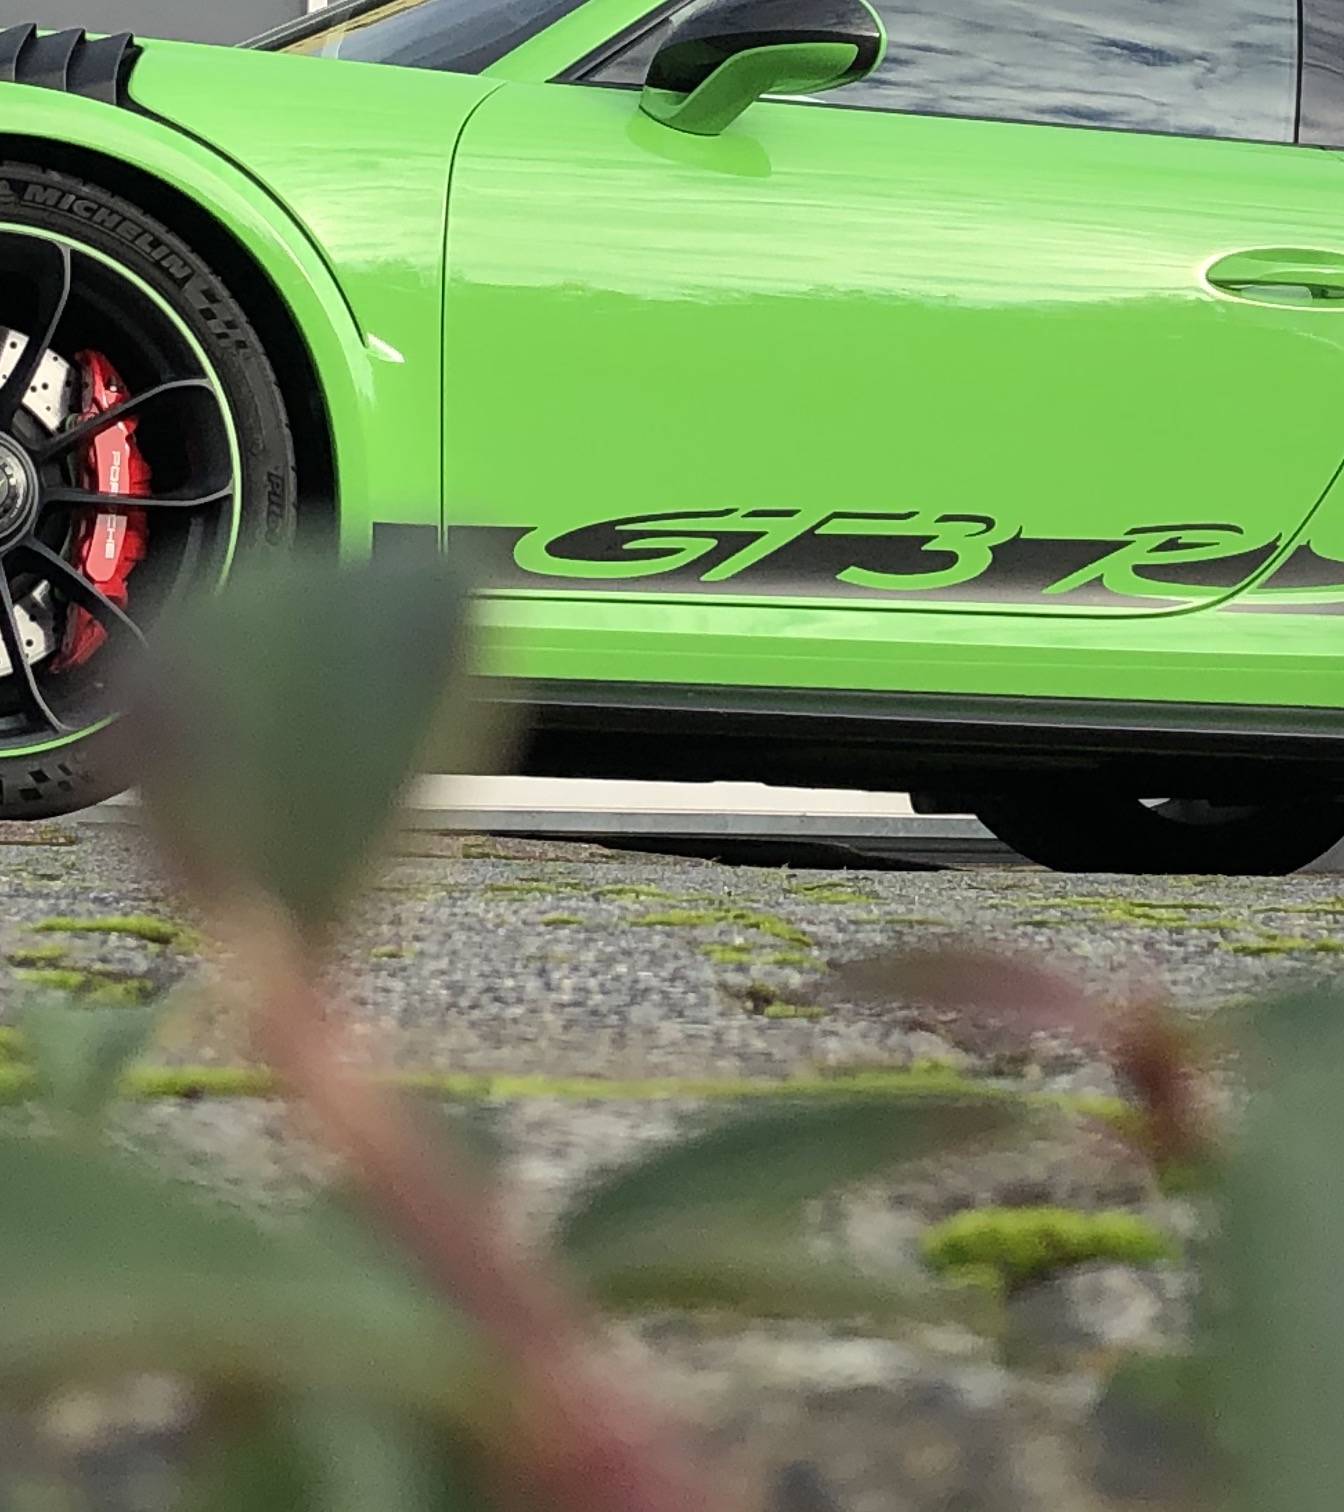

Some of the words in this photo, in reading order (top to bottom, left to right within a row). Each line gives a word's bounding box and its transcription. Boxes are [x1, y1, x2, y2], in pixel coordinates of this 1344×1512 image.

[23, 183, 195, 280] MICHELIN
[104, 450, 121, 559] PORCHE
[513, 506, 1024, 590] GT3
